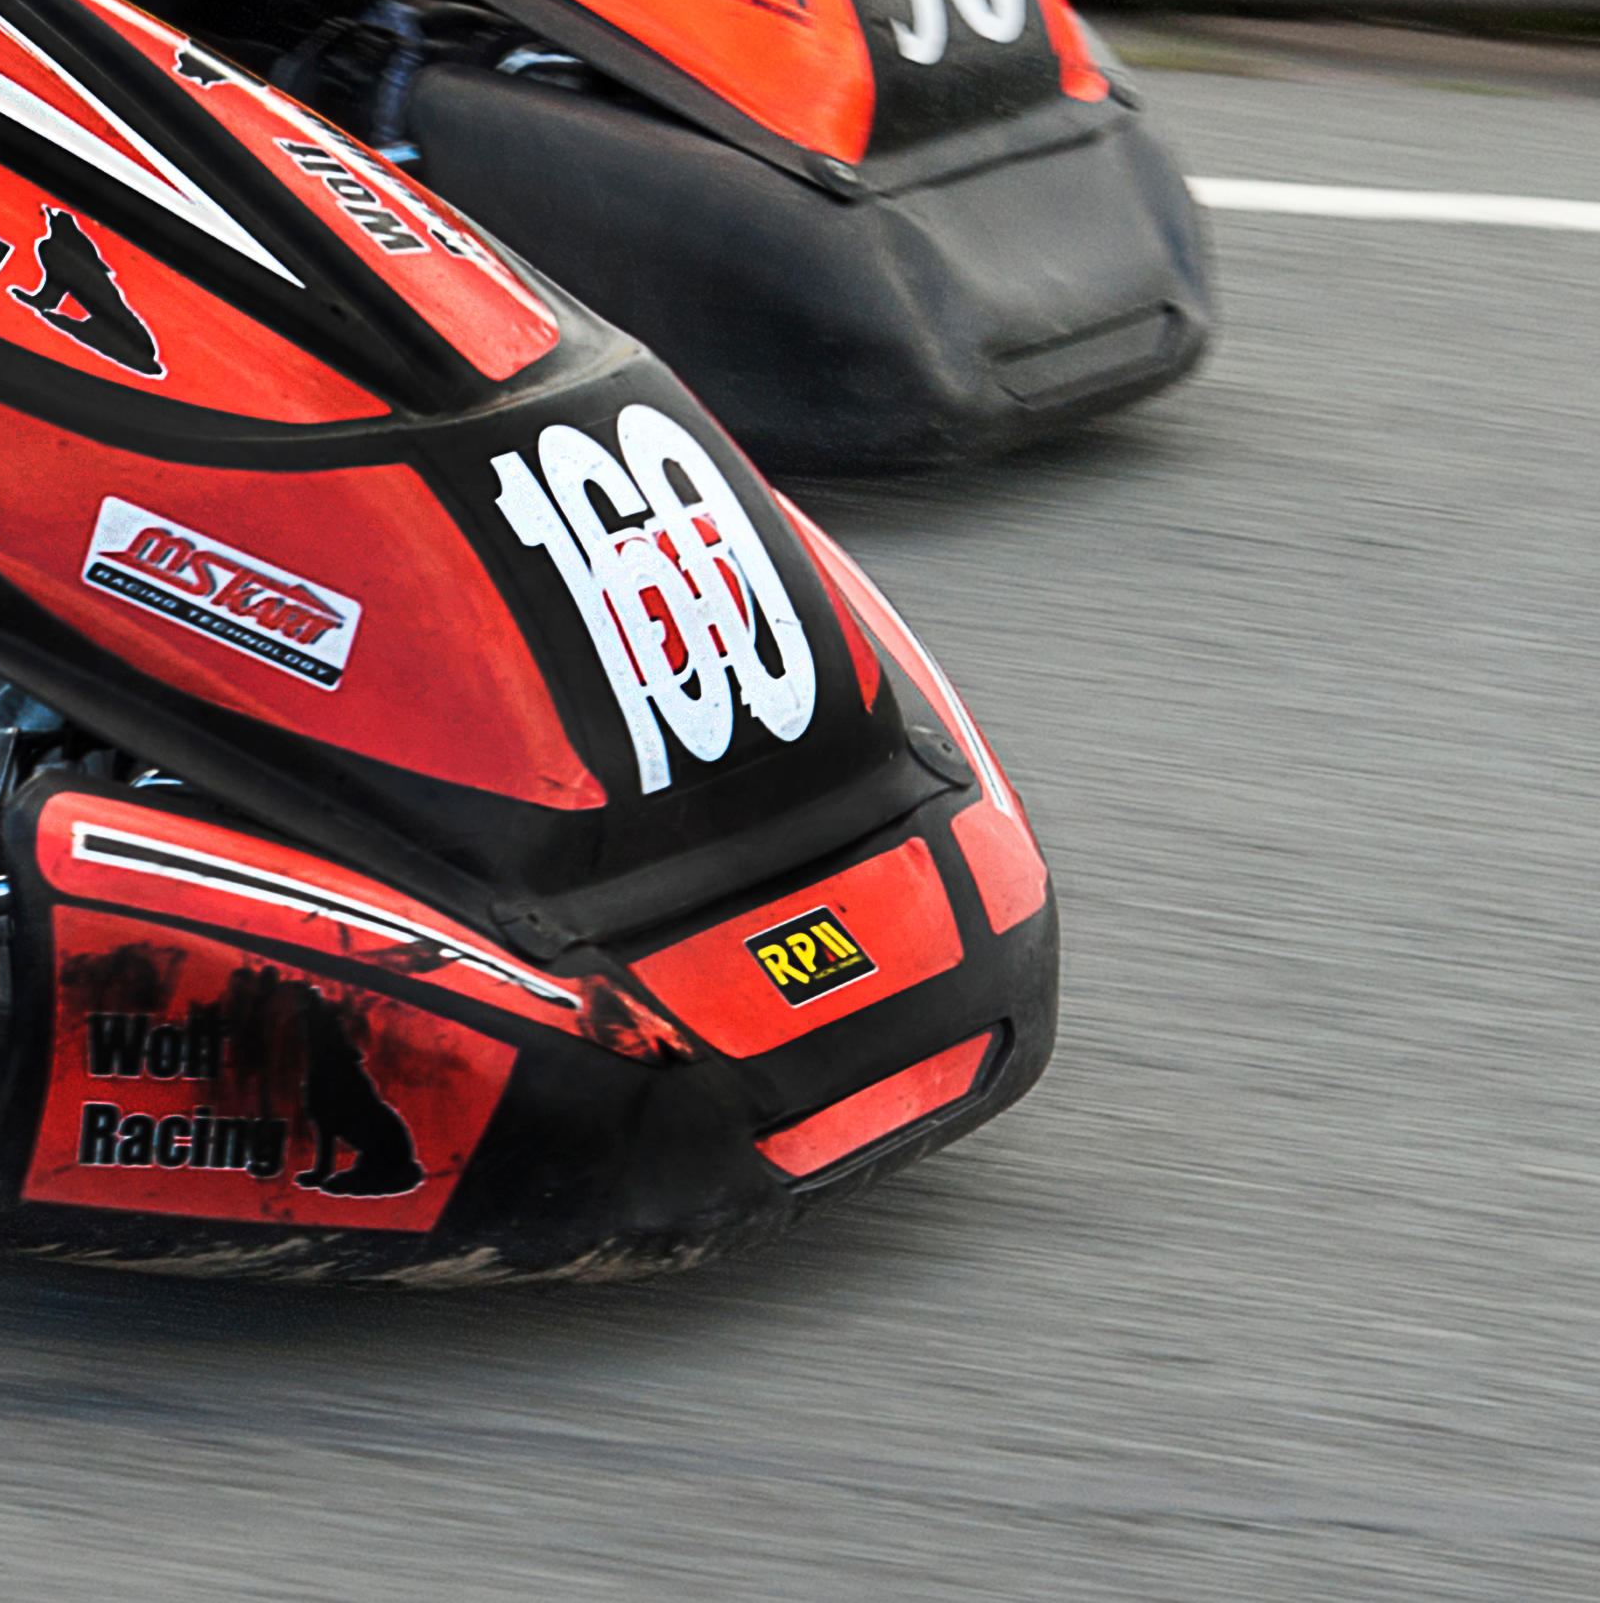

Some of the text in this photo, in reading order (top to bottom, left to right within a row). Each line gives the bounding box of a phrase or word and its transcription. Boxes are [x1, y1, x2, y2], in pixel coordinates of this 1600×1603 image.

[95, 567, 328, 677] RACING TECHNOLOGY
[77, 1100, 288, 1179] Racing
